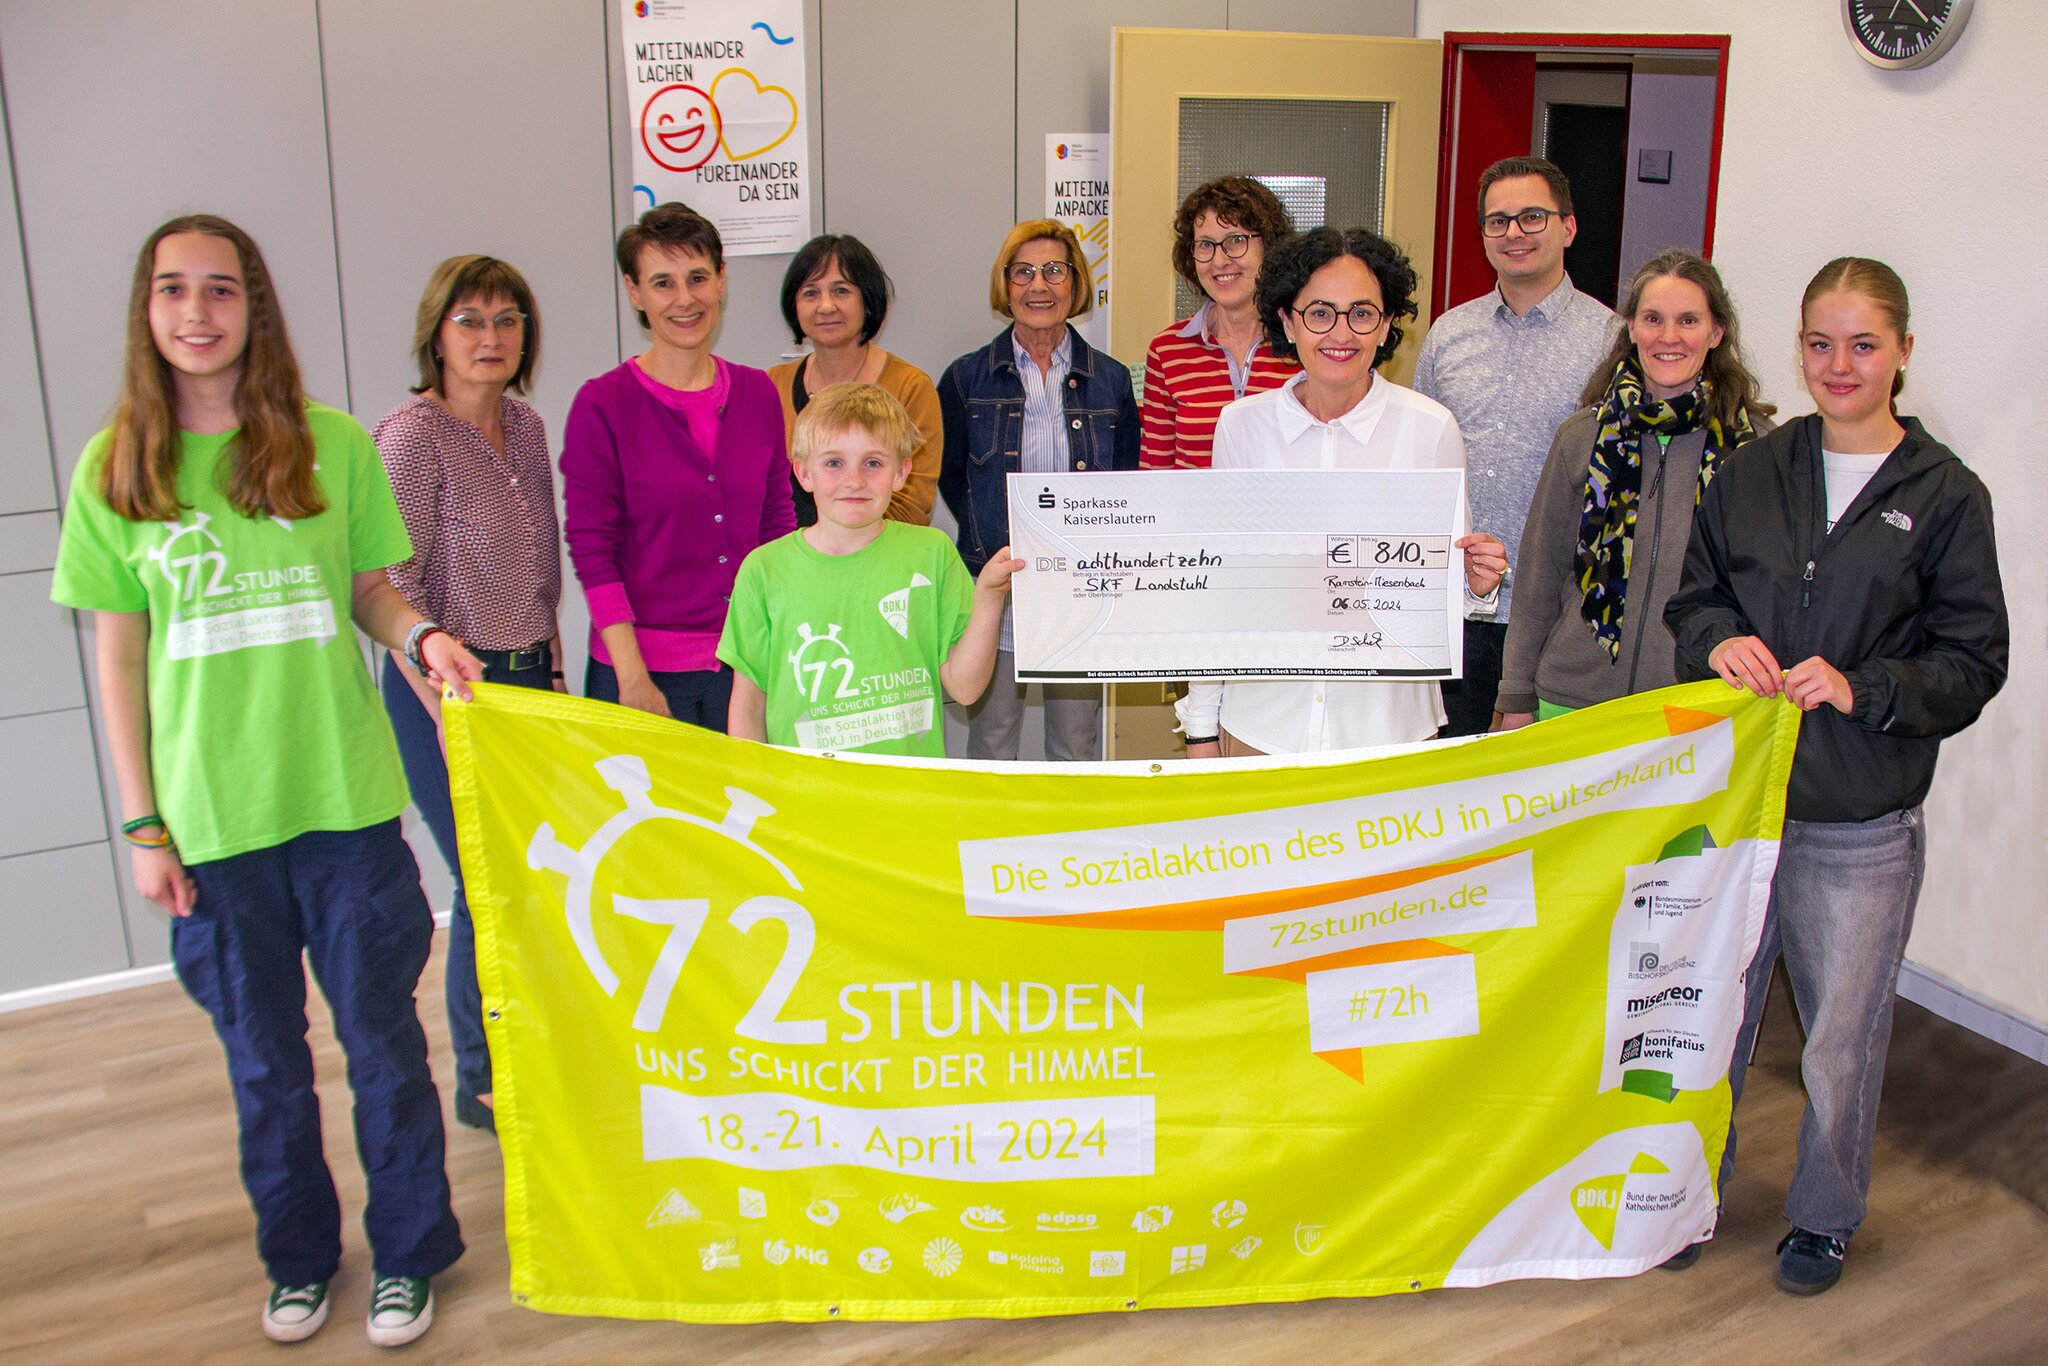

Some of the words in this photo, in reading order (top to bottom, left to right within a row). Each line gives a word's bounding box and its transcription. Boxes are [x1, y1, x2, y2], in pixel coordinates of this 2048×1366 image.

[635, 40, 744, 61] MITEINANDER
[637, 63, 693, 83] LACHEN
[696, 161, 798, 183] FÜREINANDER
[739, 184, 760, 202] DA
[765, 182, 799, 201] SEIN
[1063, 497, 1128, 511] Sparkasse
[1063, 513, 1156, 525] Kaiserslautern
[1327, 543, 1352, 563] €
[1036, 557, 1067, 571] DE
[171, 551, 233, 601] 72
[1085, 578, 1124, 592] SKF
[1134, 575, 1208, 591] Landstuhl
[882, 600, 906, 613] BDKJ
[803, 657, 859, 703] 72
[833, 697, 876, 714] SCHICKT
[881, 693, 900, 704] DER
[903, 686, 935, 700] HIMMEL
[835, 710, 906, 731] Sozialaktion
[910, 705, 924, 717] des
[991, 861, 1048, 896] Die
[1061, 838, 1272, 889] Sozialaktion
[1285, 829, 1346, 865] des
[1356, 812, 1445, 851] BDKJ
[1458, 803, 1491, 833] in
[1502, 743, 1695, 825] Deutschland
[1269, 882, 1489, 949] 72stunden.de
[611, 893, 826, 1045] 72
[1347, 983, 1430, 1022] #72h
[1627, 986, 1703, 1012] misereor
[838, 980, 1146, 1044] STUNDEN
[1643, 1048, 1673, 1060] werk
[1645, 1036, 1705, 1051] bonifatius
[635, 1042, 708, 1083] UNS
[728, 1046, 891, 1095] SCHICKT
[913, 1053, 987, 1089] DER
[1008, 1047, 1155, 1084] HIMMEL
[697, 1107, 841, 1154] 18.-21.
[863, 1123, 977, 1169] April
[997, 1117, 1108, 1162] 2024
[1576, 1188, 1616, 1209] BDKJ
[1625, 1202, 1669, 1212] Katholischen
[1626, 1191, 1645, 1201] Bund
[1645, 1194, 1658, 1202] der
[1053, 1211, 1097, 1226] dpsg
[1010, 1253, 1061, 1267] Kolping
